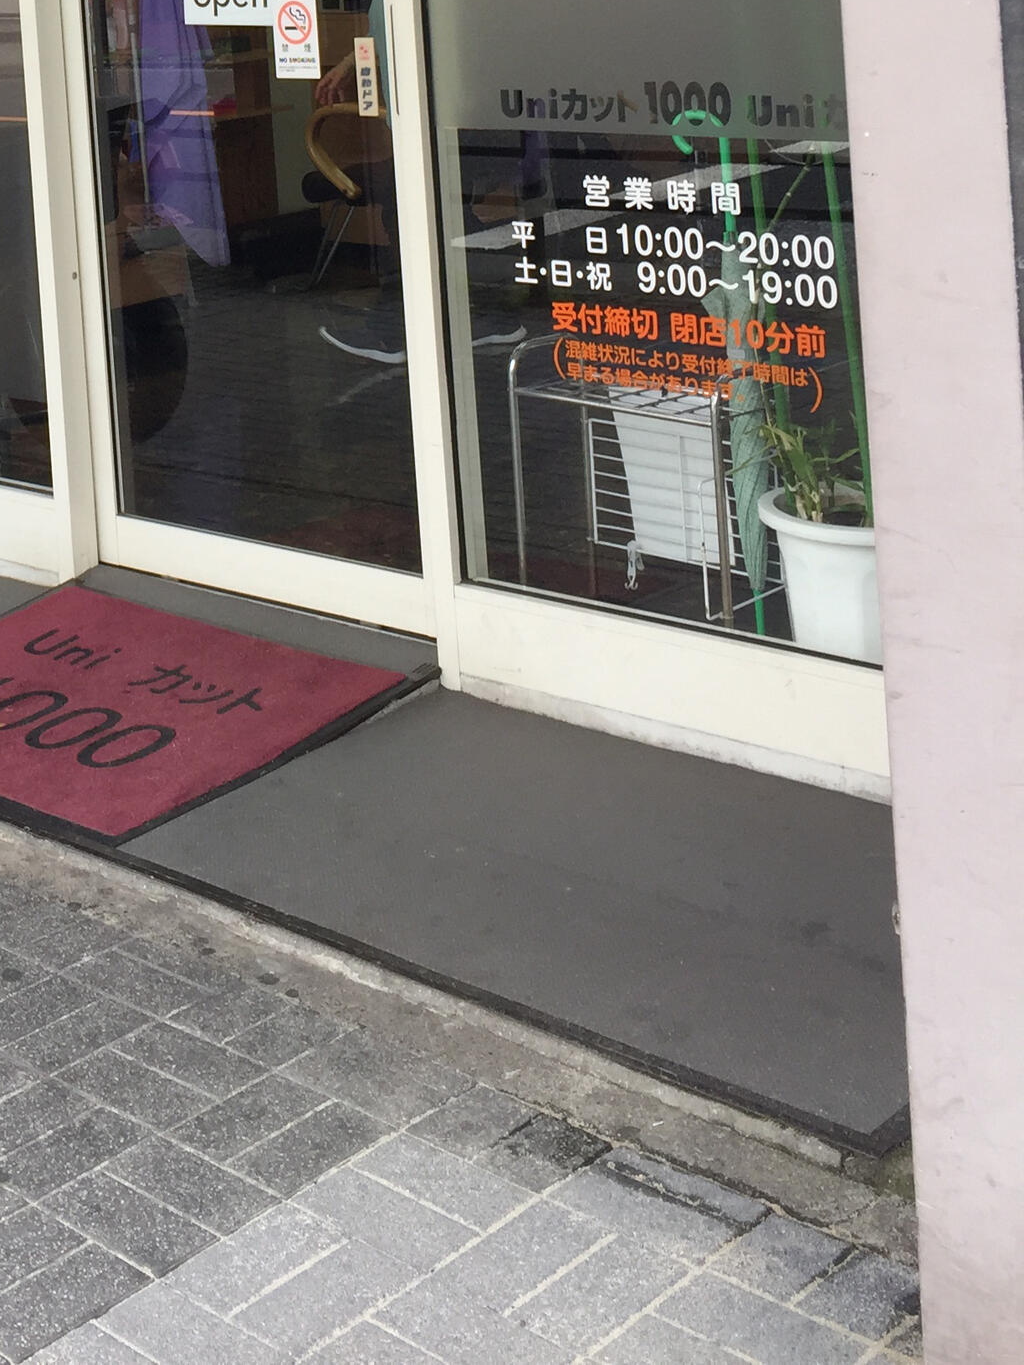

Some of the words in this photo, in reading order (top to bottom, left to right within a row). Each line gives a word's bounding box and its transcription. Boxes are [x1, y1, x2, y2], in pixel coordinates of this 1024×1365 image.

[582, 175, 741, 216] 営業時間
[552, 302, 659, 340] 受付締切
[23, 629, 122, 671] Uni
[127, 663, 266, 716] カット
